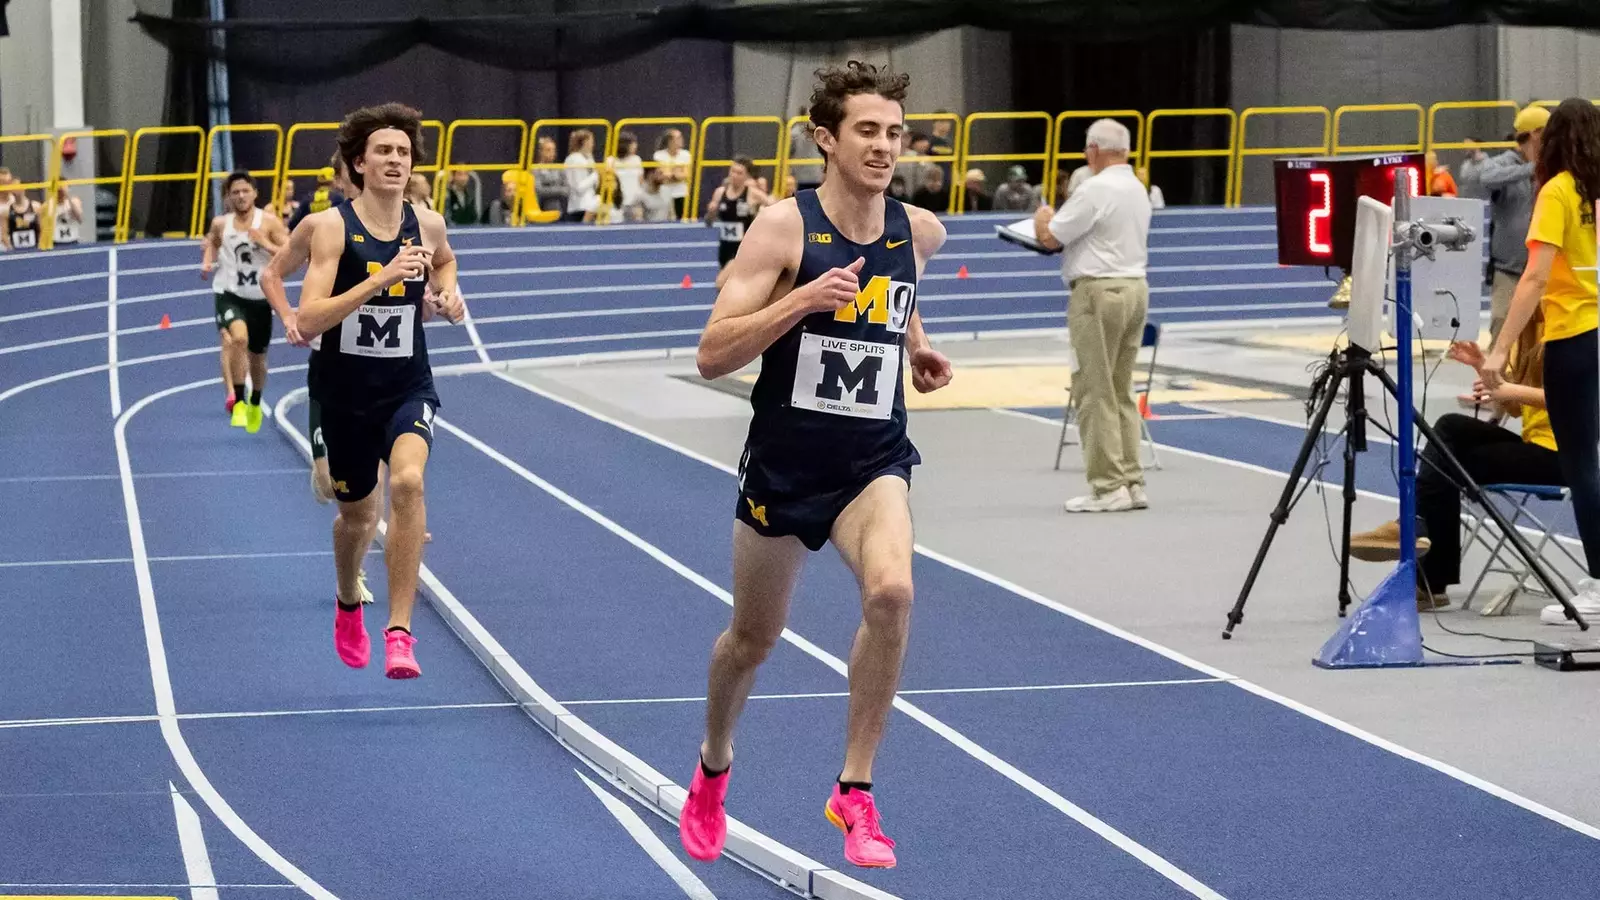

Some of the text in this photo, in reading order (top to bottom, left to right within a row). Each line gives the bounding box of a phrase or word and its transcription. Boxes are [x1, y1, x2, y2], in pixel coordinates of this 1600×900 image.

[1383, 156, 1403, 165] LYNX
[1309, 173, 1330, 253] 2
[237, 271, 258, 286] M
[377, 307, 404, 315] SPLITS
[834, 275, 891, 324] M
[893, 285, 912, 329] 9
[356, 314, 402, 348] M
[821, 339, 885, 355] LIVE SPLITS
[815, 350, 883, 405] M
